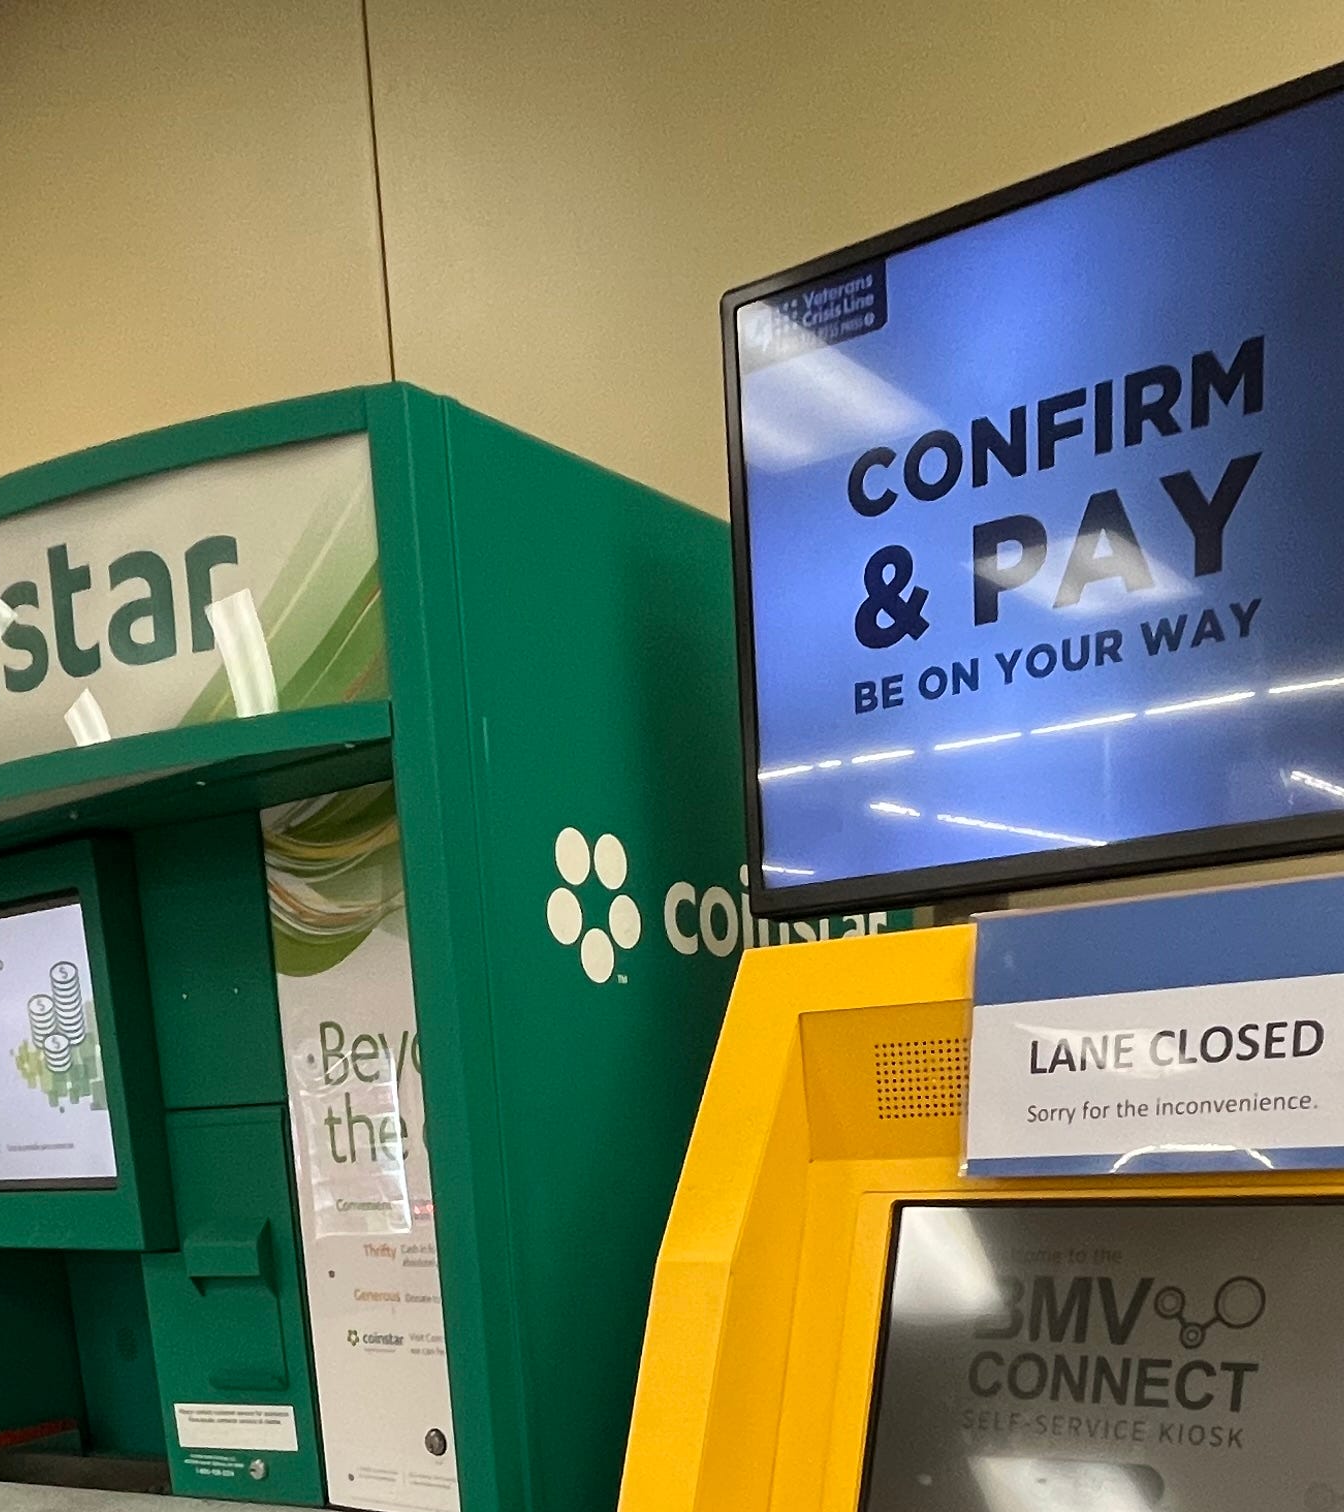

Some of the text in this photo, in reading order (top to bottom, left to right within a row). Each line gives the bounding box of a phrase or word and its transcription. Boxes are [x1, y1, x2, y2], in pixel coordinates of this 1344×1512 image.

[847, 335, 1265, 517] CONFIRM
[855, 451, 1263, 648] & PAY
[855, 598, 1262, 714] BE ON YOUR WAY
[1030, 1018, 1325, 1075] LANE CLOSED
[324, 1092, 409, 1165] the
[1026, 1091, 1318, 1125] Sorry for the inconvenience.
[363, 1243, 397, 1260] Thrifty
[362, 1332, 404, 1346] coinstar
[972, 1275, 1155, 1346] BMV
[968, 1350, 1260, 1413] CONNECT
[961, 1409, 1244, 1449] SELF-SERVICE KIOSK
